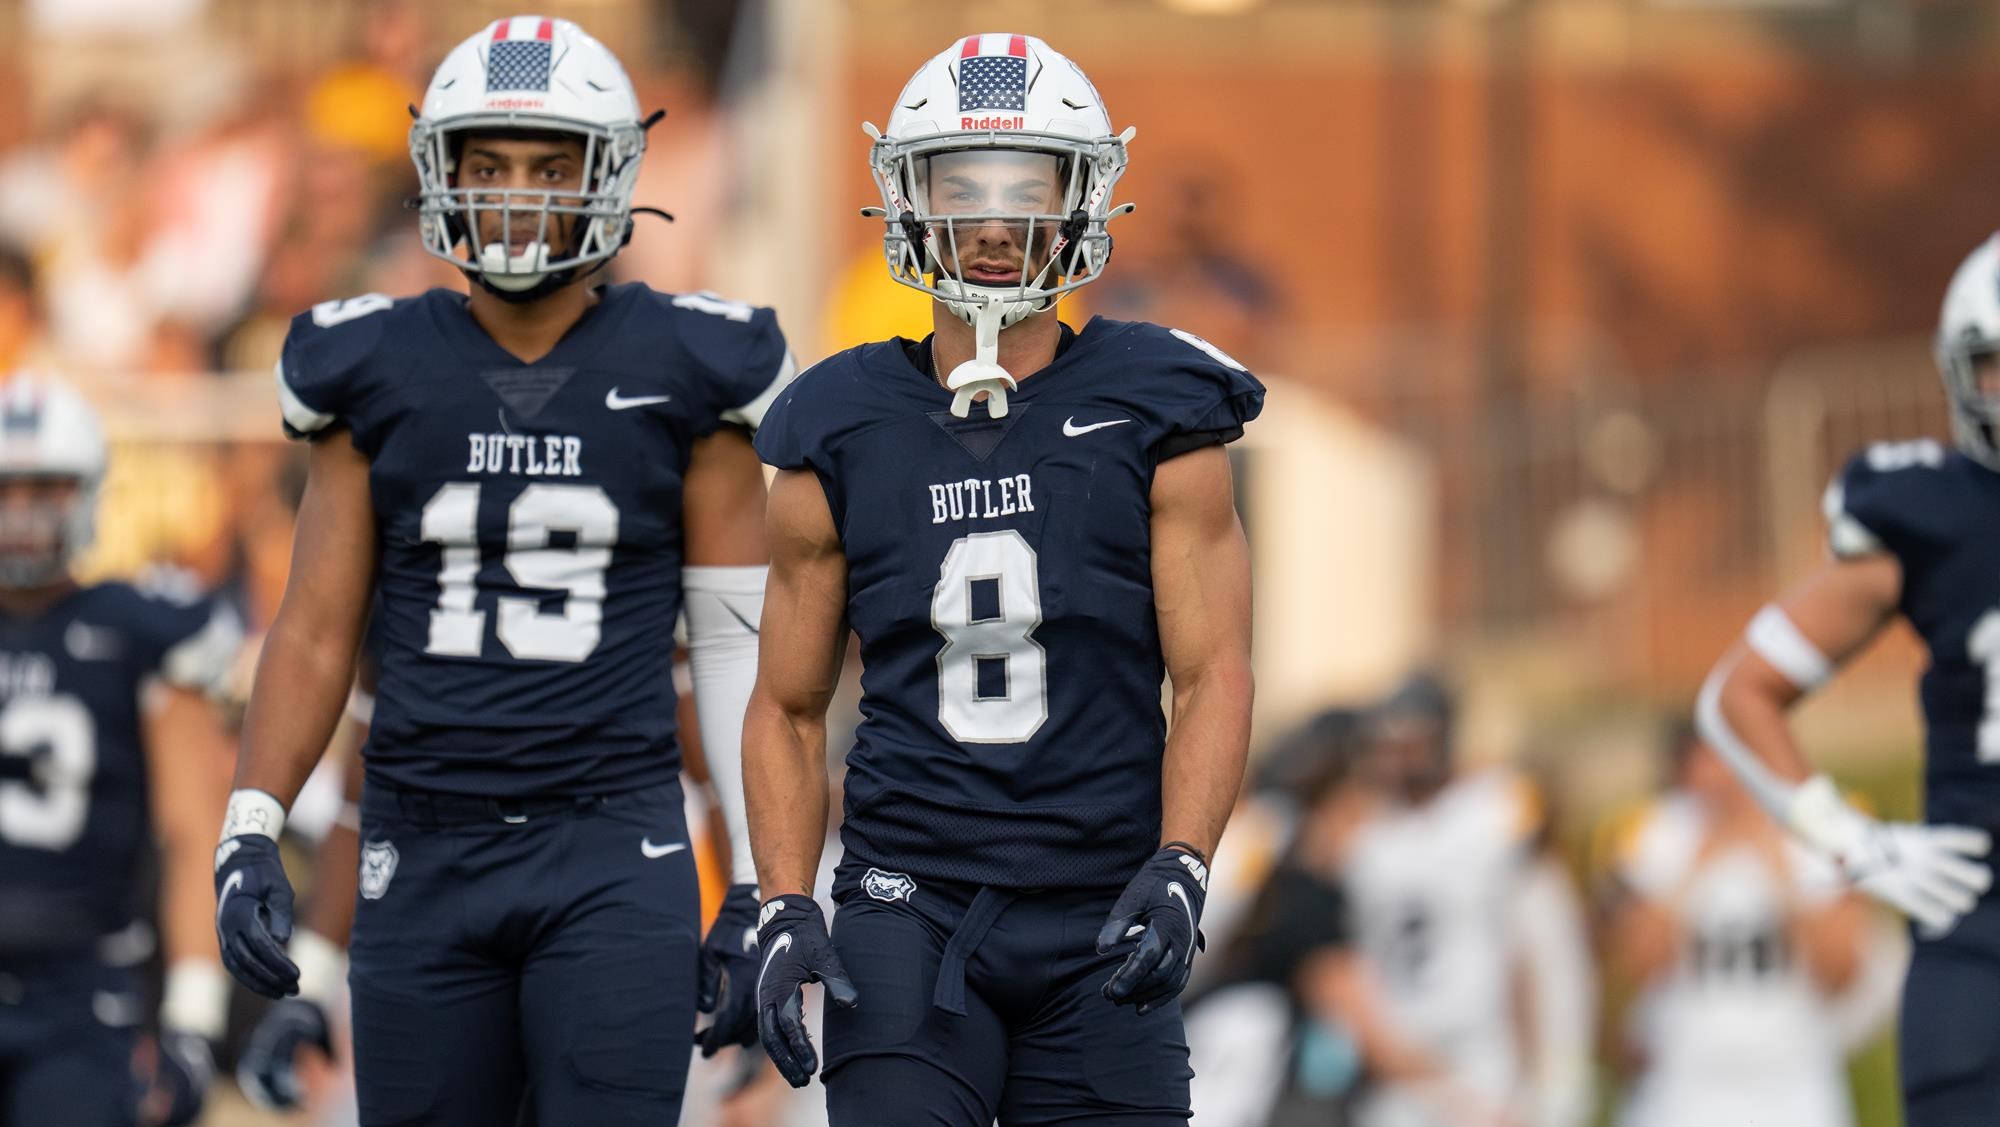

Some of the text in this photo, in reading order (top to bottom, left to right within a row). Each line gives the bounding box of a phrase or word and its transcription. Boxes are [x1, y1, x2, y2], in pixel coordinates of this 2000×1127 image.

[961, 117, 1024, 130] Riddell
[467, 433, 582, 476] BUTLER
[929, 474, 1035, 524] BUTLER
[421, 482, 620, 662] 19
[931, 529, 1049, 744] 8
